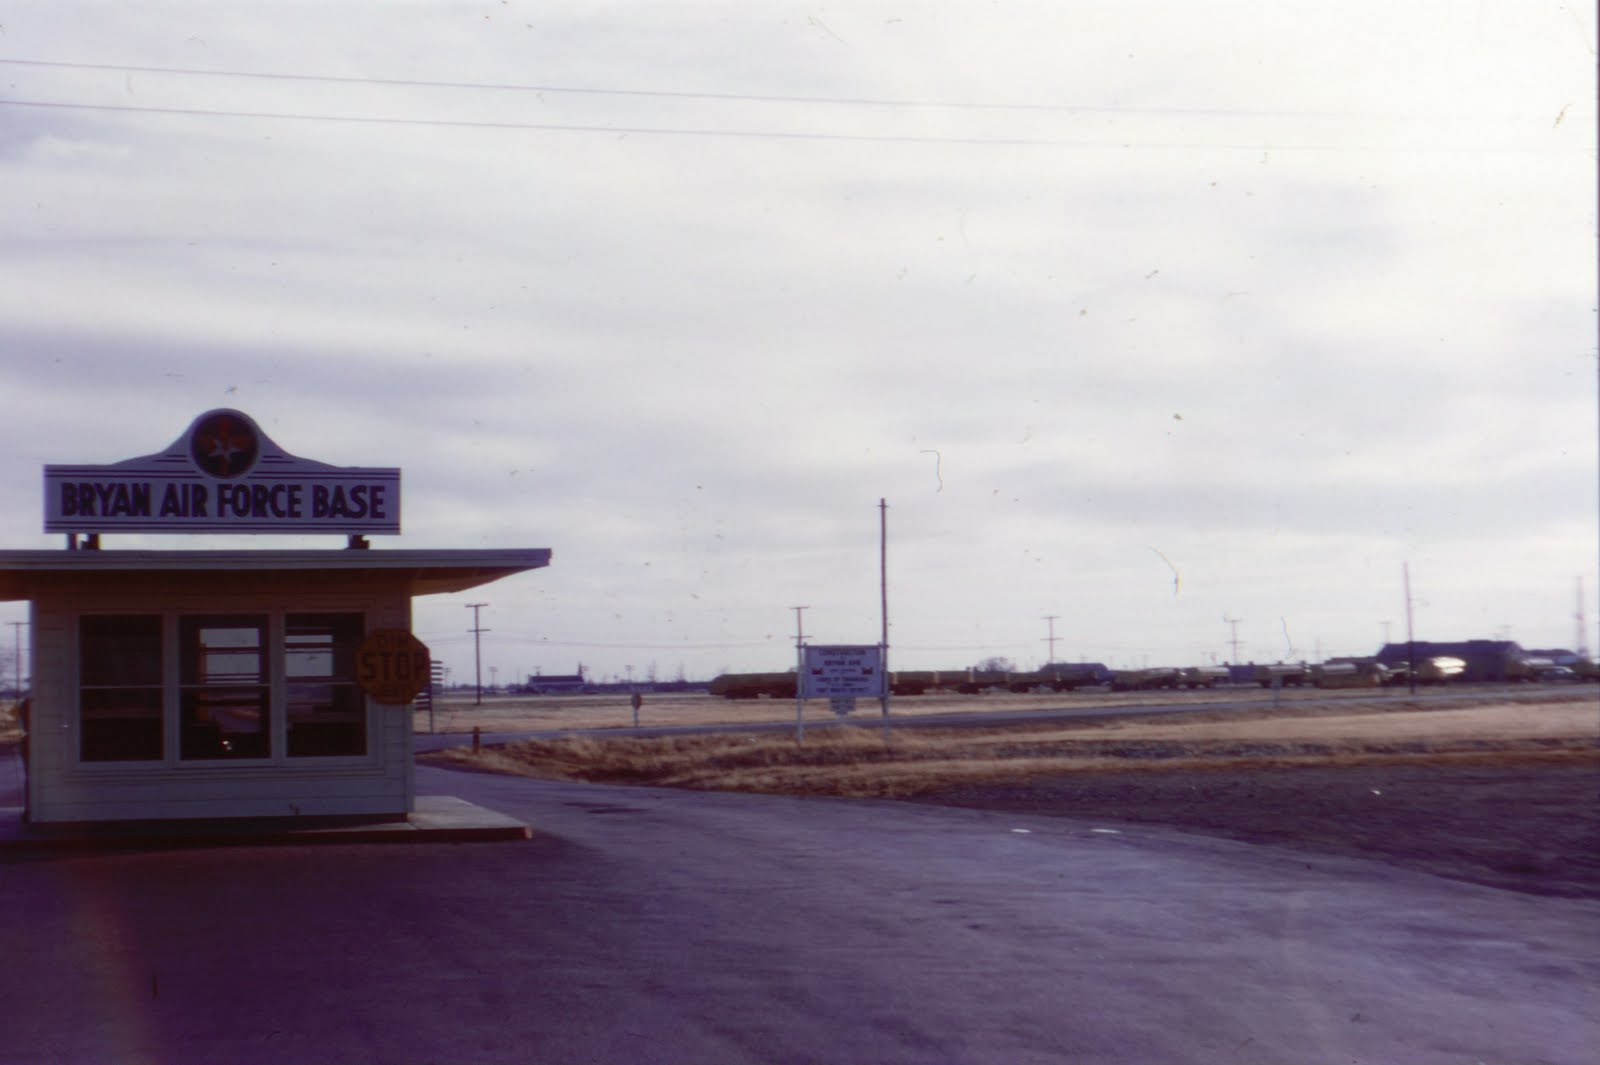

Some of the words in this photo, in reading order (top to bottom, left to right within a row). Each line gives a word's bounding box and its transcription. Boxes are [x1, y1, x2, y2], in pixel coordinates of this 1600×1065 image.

[61, 482, 151, 517] BRYAN
[160, 483, 208, 517] AIR
[217, 483, 302, 518] FORCE
[312, 485, 386, 518] BASE
[360, 651, 427, 680] STOP
